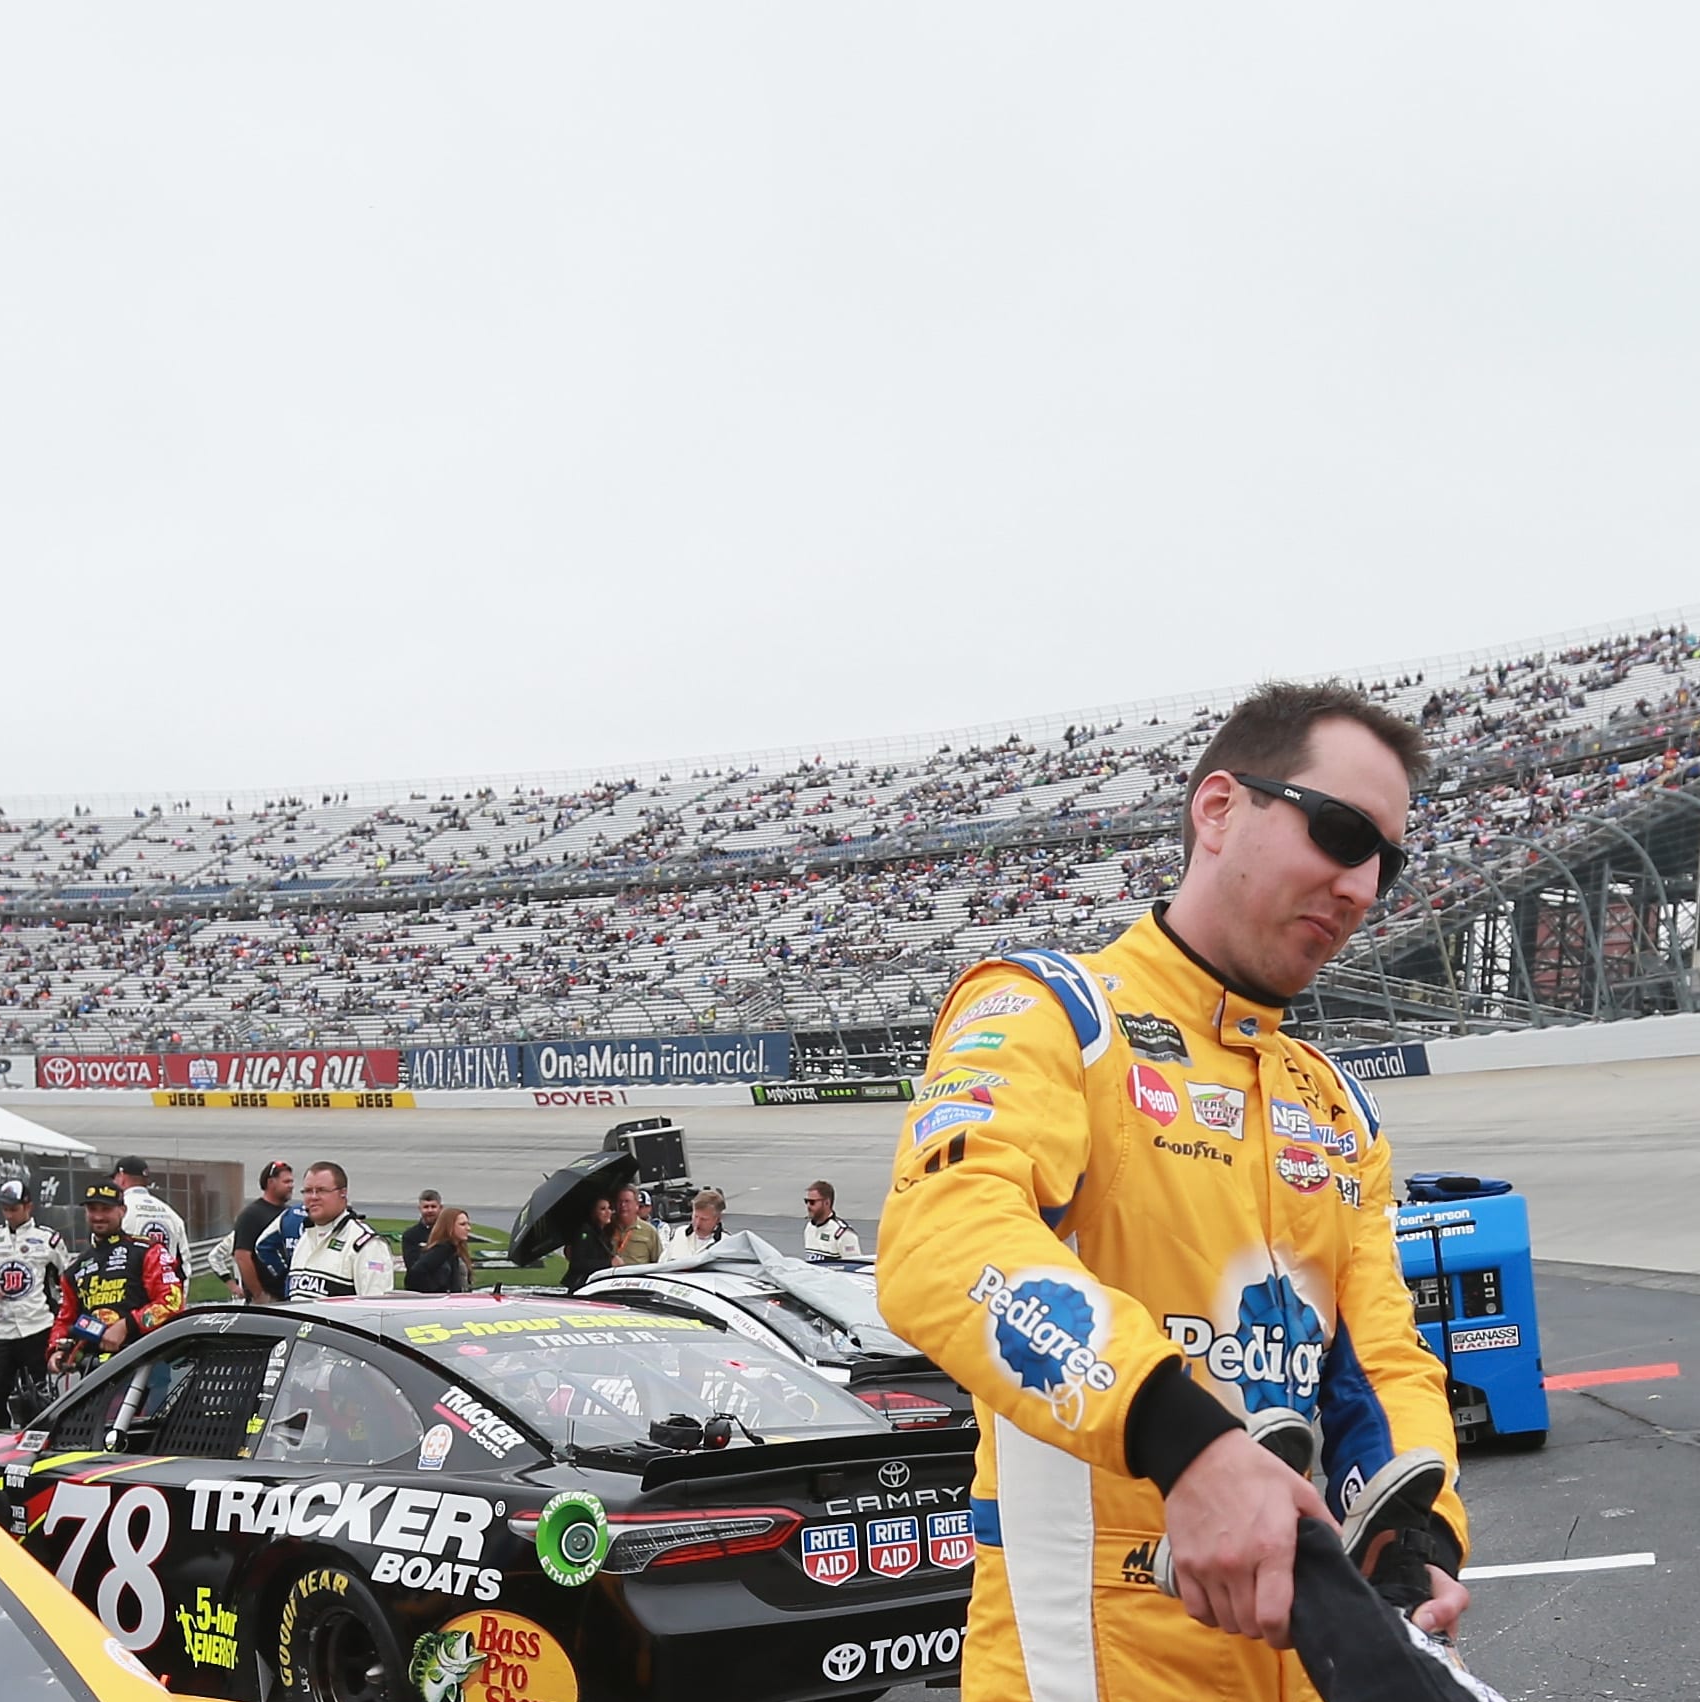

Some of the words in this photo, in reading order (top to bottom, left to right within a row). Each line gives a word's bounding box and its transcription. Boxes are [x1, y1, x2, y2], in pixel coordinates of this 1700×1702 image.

[412, 1046, 511, 1089] AQUAFINA
[540, 1043, 654, 1079] OneMain
[660, 1039, 764, 1076] Financial
[76, 1061, 152, 1084] TOYOTA
[226, 1055, 315, 1090] LUCAS
[320, 1055, 367, 1089] OIL
[167, 1094, 205, 1107] JEGS
[229, 1094, 268, 1107] JEGS
[291, 1094, 330, 1107] JEGS
[355, 1094, 393, 1107] JEGS
[533, 1090, 614, 1106] DOVER
[765, 1084, 819, 1101] MONSTER
[820, 1088, 857, 1096] ENERGY
[404, 1316, 562, 1345] 5-hour
[559, 1314, 716, 1331] ENERGY
[526, 1331, 622, 1348] TRUEX
[625, 1331, 668, 1343] JR.
[968, 1263, 1117, 1392] Pedigree
[1465, 1328, 1517, 1343] GANASSI
[1454, 1338, 1518, 1351] RACING
[440, 1385, 526, 1452] TRACKER
[468, 1427, 506, 1459] boats
[6, 1474, 26, 1488] ROW
[542, 1491, 607, 1527] AMERICAN
[826, 1486, 965, 1517] CAMRY
[185, 1480, 493, 1562] TRACKER
[873, 1523, 913, 1544] RITE
[933, 1517, 969, 1537] RITE
[808, 1529, 850, 1549] RITE
[938, 1541, 969, 1562] AID
[43, 1481, 170, 1652] 78
[540, 1556, 602, 1586] ETHANOL
[815, 1555, 849, 1577] AID
[880, 1549, 911, 1570] AID
[371, 1552, 504, 1601] BOATS
[196, 1586, 238, 1638] 5-hour
[477, 1615, 541, 1659] Bass
[193, 1632, 238, 1670] ENERGY
[478, 1651, 529, 1690] Pro
